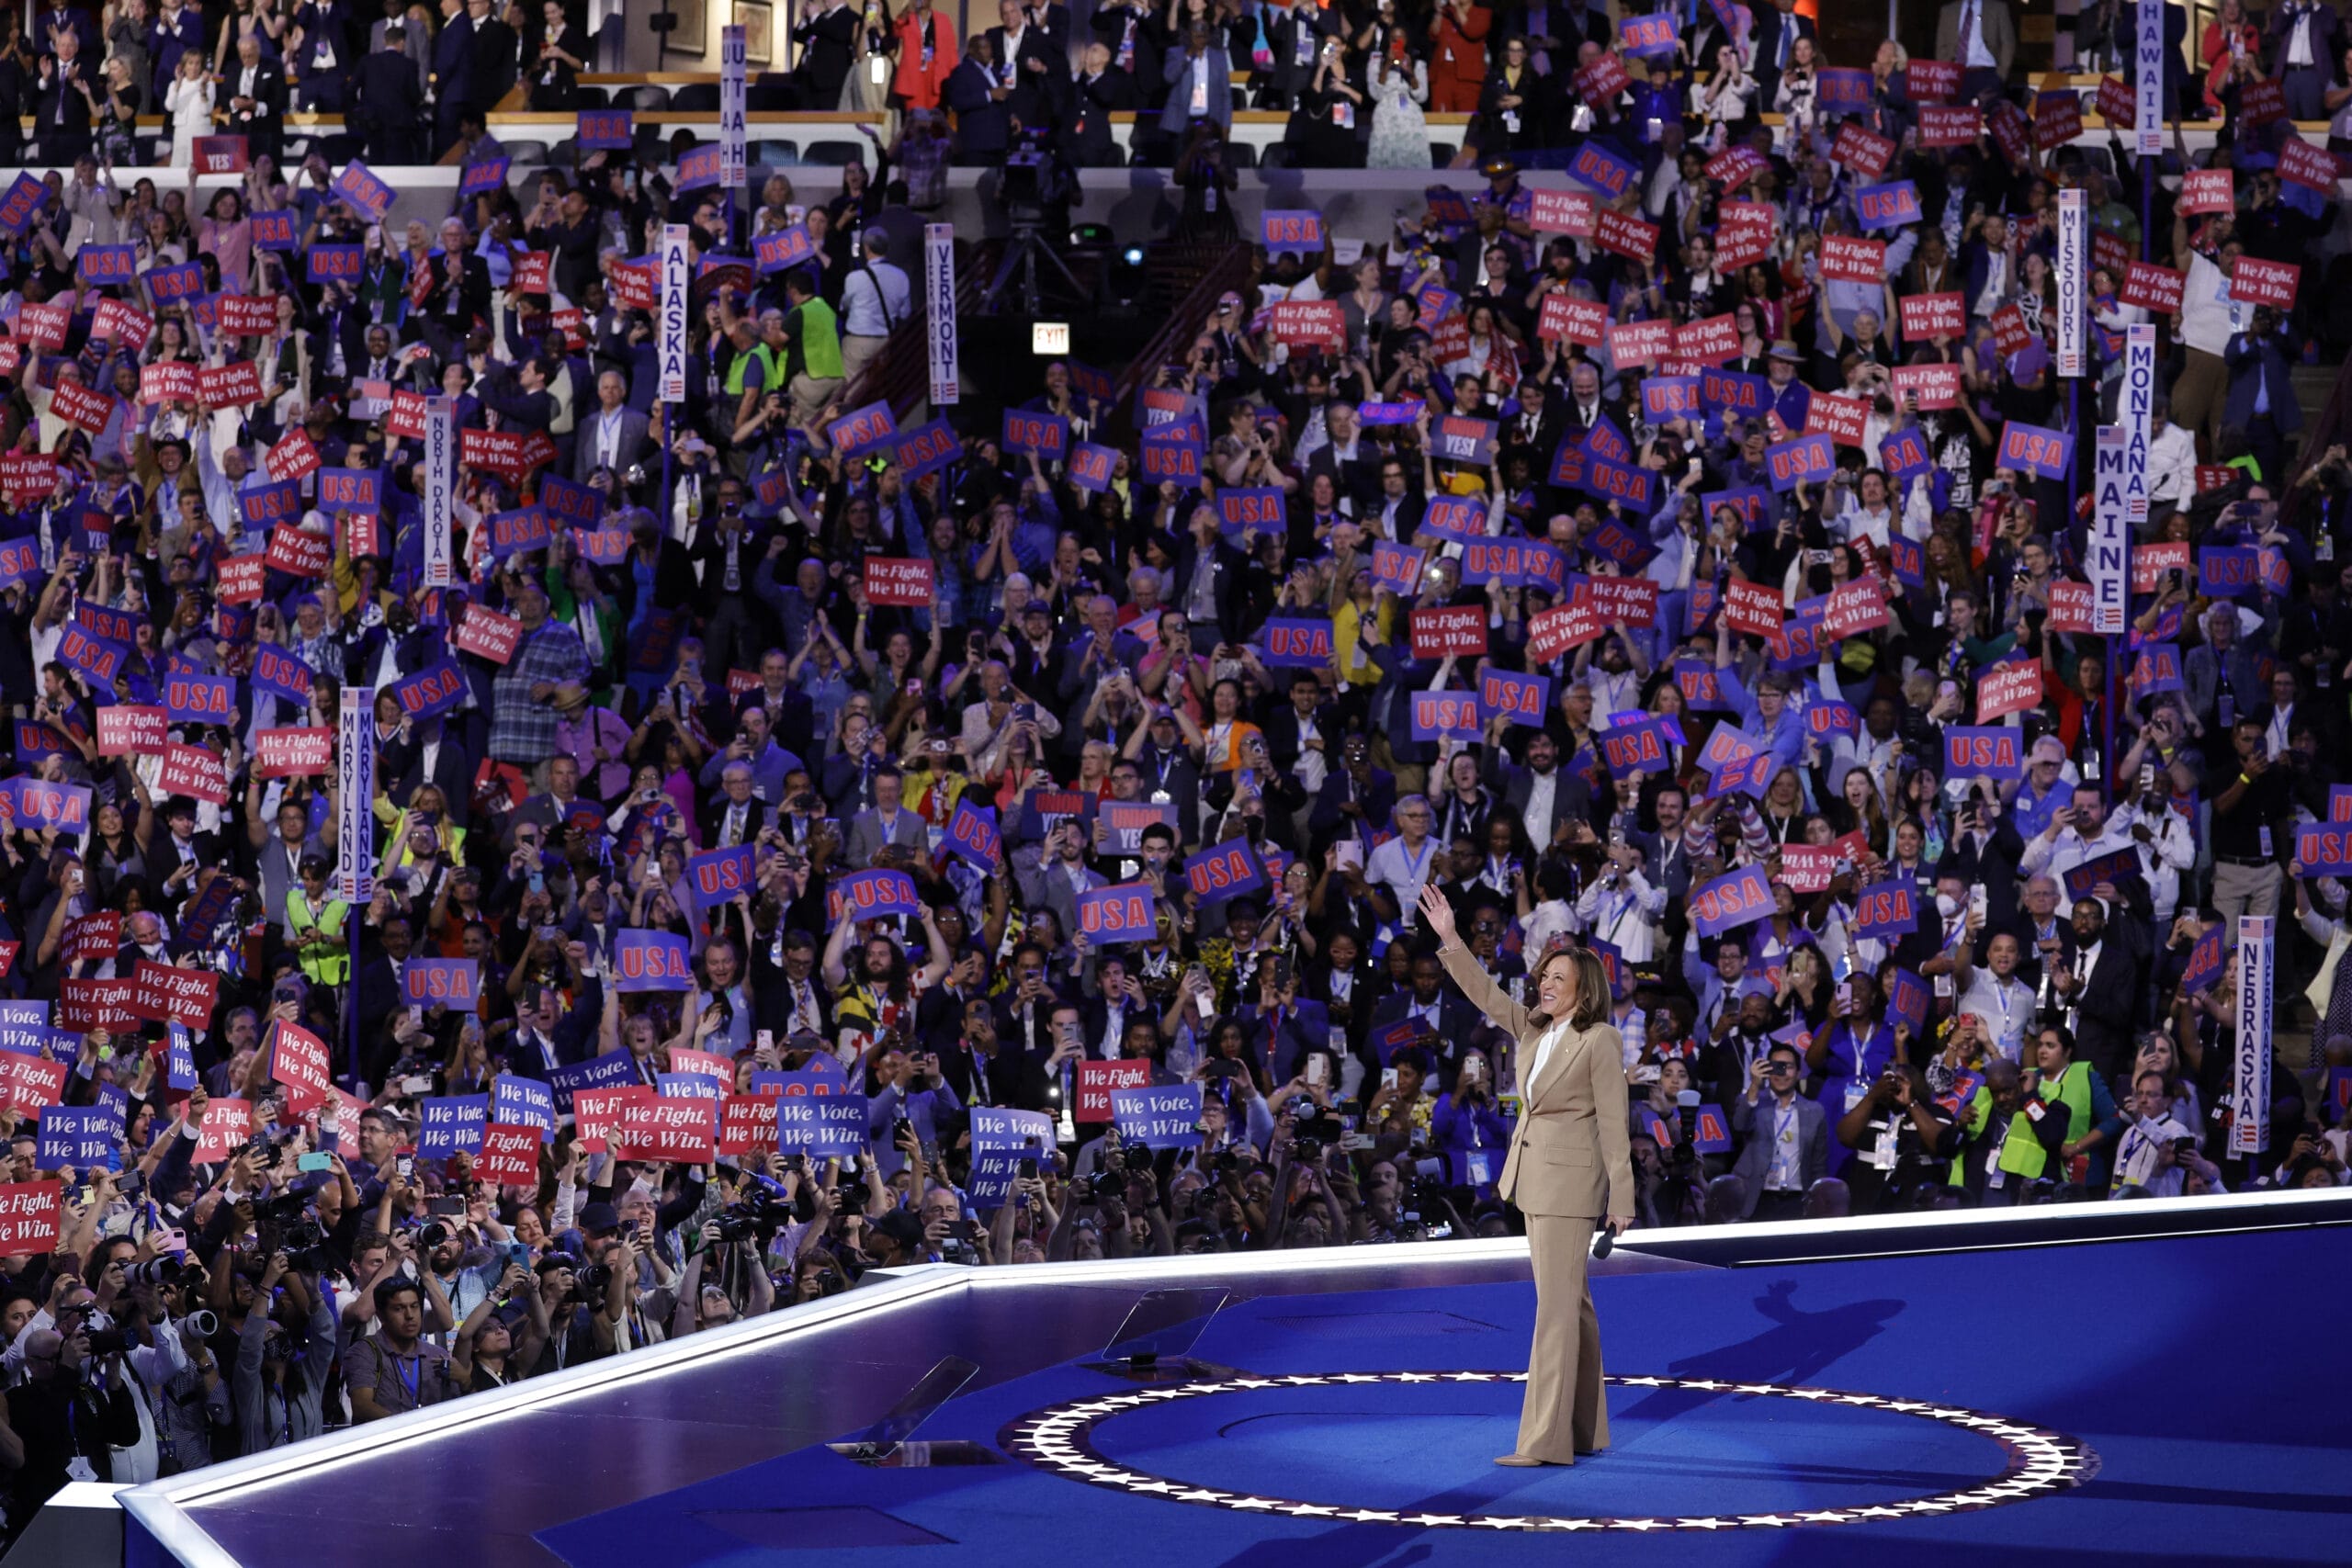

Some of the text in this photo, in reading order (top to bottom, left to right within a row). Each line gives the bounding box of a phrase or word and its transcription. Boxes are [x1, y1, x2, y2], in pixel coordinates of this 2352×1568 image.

[1624, 20, 1673, 46] USA
[2142, 4, 2161, 130] HAWAII
[731, 43, 745, 164] UTAH
[343, 168, 387, 209] USA
[1863, 191, 1914, 218] USA
[1267, 218, 1318, 242] USA
[84, 253, 132, 274] USA
[312, 253, 360, 273] USA
[2239, 263, 2257, 276] We
[152, 269, 199, 297] USA
[2063, 209, 2075, 350] MISSOURI
[2237, 279, 2256, 292] We
[666, 245, 684, 375] ALASKA
[937, 245, 953, 379] VERMONT
[1277, 307, 1296, 319] We
[1277, 322, 1298, 334] We
[1704, 376, 1757, 407] USA
[1812, 398, 1826, 412] We
[835, 412, 890, 451] USA
[1810, 414, 1826, 429] We
[2127, 345, 2152, 495] MONTANA
[1009, 419, 1058, 448] USA
[1772, 443, 1829, 478] USA
[2008, 432, 2062, 468] USA
[323, 477, 373, 502] USA
[433, 417, 443, 558] NORTH DAKOTA
[1224, 497, 1280, 522] USA
[495, 514, 547, 544] USA
[2098, 449, 2123, 603] MAINE
[869, 564, 888, 577] We
[1471, 547, 1520, 573] USA
[869, 581, 889, 594] We
[1417, 616, 1435, 628] We
[1272, 628, 1329, 657] USA
[1418, 635, 1439, 648] We
[63, 633, 115, 678] USA
[260, 653, 309, 695] USA
[1984, 678, 1998, 694] We
[170, 682, 227, 712] USA
[401, 667, 460, 712] USA
[1485, 678, 1539, 714] USA
[1419, 701, 1478, 729] USA
[1984, 696, 2002, 710] We
[103, 715, 123, 728] We
[104, 732, 127, 745] We
[262, 735, 283, 749] We
[1607, 732, 1660, 766] USA
[171, 750, 191, 766] We
[264, 753, 285, 767] We
[1950, 737, 2015, 767] USA
[166, 767, 190, 784] We
[343, 714, 353, 871] MARYLAND
[359, 714, 370, 872] MARYLAND
[24, 790, 81, 823] USA
[956, 811, 1001, 863] USA
[699, 856, 752, 894] USA
[1190, 851, 1250, 895] USA
[853, 880, 915, 906] USA
[1697, 876, 1767, 920] USA
[1082, 897, 1148, 931] USA
[1859, 891, 1911, 926] USA
[623, 948, 685, 977] USA
[140, 969, 209, 996] We Fight,
[409, 969, 469, 998] USA
[66, 986, 130, 1005] We Fight
[136, 992, 204, 1017] We Win.
[3, 1008, 42, 1025] Vote,
[68, 1008, 93, 1023] We
[3, 1029, 40, 1047] Win.
[175, 1034, 190, 1052] We
[2239, 943, 2258, 1119] NEBRASKA
[281, 1032, 328, 1066] We Fight,
[12, 1062, 56, 1089] Fight,
[174, 1057, 192, 1075] We
[278, 1054, 330, 1089] We Win.
[552, 1061, 628, 1088] We Vote,
[677, 1057, 731, 1083] We Fight,
[665, 1081, 717, 1099] We Vote,
[1084, 1069, 1145, 1089] We Fight,
[500, 1084, 549, 1109] We Vote,
[581, 1100, 605, 1115] We
[1083, 1093, 1108, 1109] We
[1117, 1095, 1194, 1114] We Vote,
[216, 1106, 248, 1128] Fight,
[428, 1105, 483, 1122] We Vote,
[499, 1107, 550, 1129] We Win.
[625, 1106, 707, 1126] We Fight,
[729, 1104, 748, 1119] We
[784, 1105, 862, 1122] We Vote,
[46, 1115, 108, 1134] We Vote,
[583, 1122, 608, 1139] We
[726, 1127, 747, 1143] We
[785, 1127, 864, 1145] We Win.
[977, 1117, 1050, 1137] We Vote,
[1121, 1122, 1148, 1137] We
[44, 1140, 107, 1157] We Win.
[195, 1133, 218, 1151] We
[424, 1128, 481, 1146] We Win.
[485, 1132, 533, 1153] Fight,
[623, 1131, 707, 1149] We Win.
[490, 1155, 529, 1172] Win.
[981, 1158, 1003, 1174] We
[974, 1181, 1000, 1196] We
[13, 1191, 54, 1215] Fight,
[17, 1222, 54, 1239] Win.
